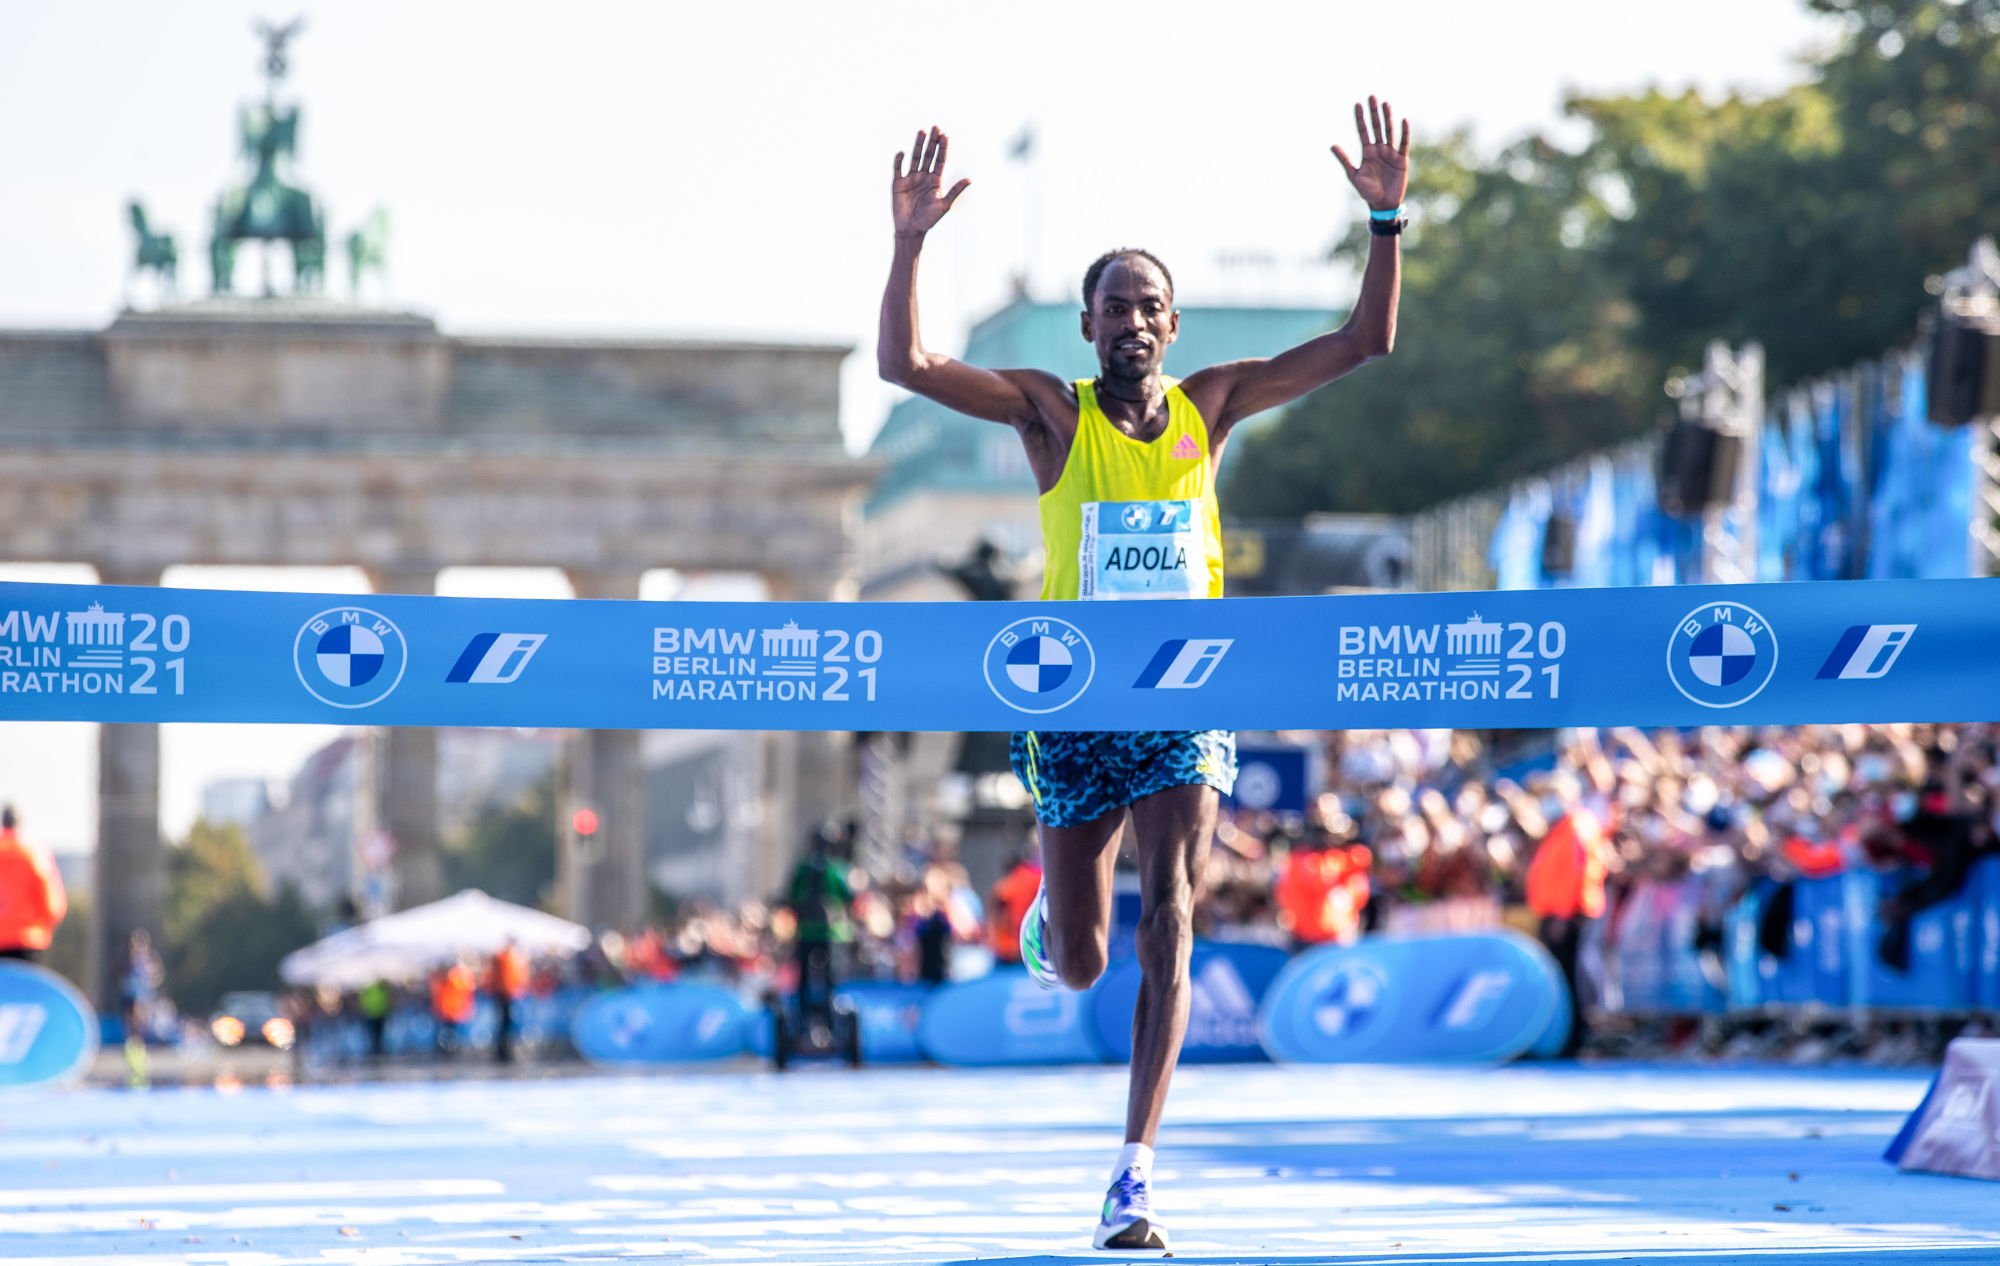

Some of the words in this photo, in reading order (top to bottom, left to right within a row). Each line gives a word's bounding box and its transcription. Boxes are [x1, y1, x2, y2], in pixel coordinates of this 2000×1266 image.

[1104, 547, 1188, 571] ADOLA
[0, 610, 61, 643] MW
[129, 613, 190, 653] 20
[310, 611, 392, 637] BMW
[1000, 621, 1081, 648] BMW
[1682, 607, 1764, 639] BMW
[653, 627, 756, 655] BMW
[823, 629, 883, 664] 20
[1338, 624, 1441, 656] BMW
[1507, 621, 1567, 660] 20
[0, 646, 61, 668] RLIN
[653, 656, 756, 676] BERLIN
[1338, 658, 1440, 678] BERLIN
[2, 671, 123, 694] RATHON
[129, 656, 185, 695] 21
[822, 666, 877, 702] 21
[1505, 663, 1560, 700] 21
[652, 679, 816, 701] MARATHON
[1337, 680, 1500, 702] MARATHON
